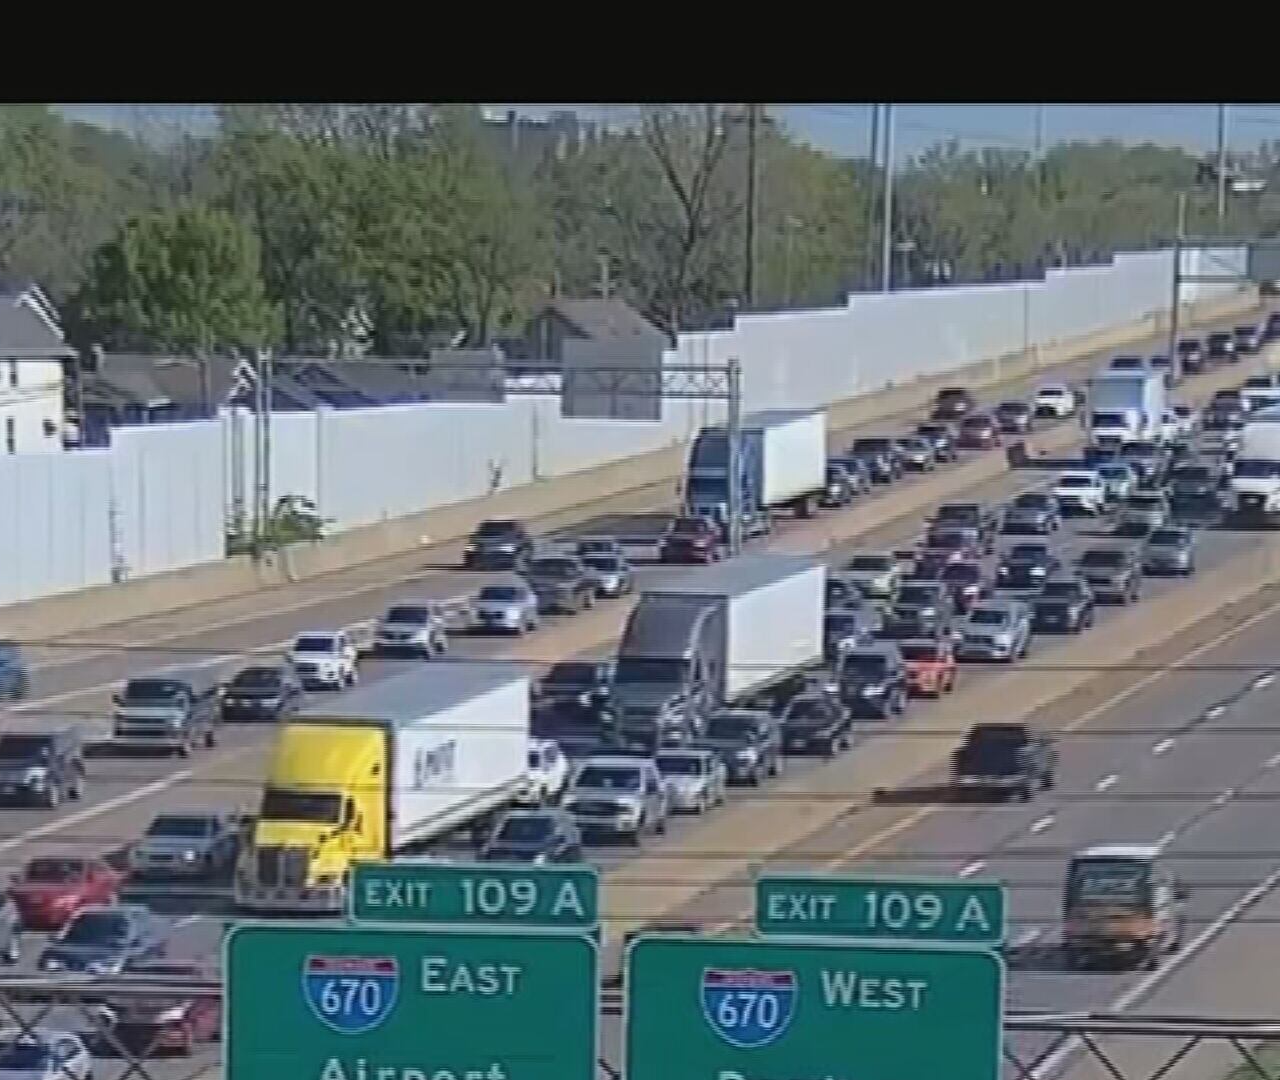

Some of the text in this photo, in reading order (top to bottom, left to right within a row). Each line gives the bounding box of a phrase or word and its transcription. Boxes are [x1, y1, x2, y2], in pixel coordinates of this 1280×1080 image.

[365, 879, 584, 916] EXIT 109 A
[768, 893, 989, 931] EXIT 109 A
[421, 957, 521, 996] EAST
[822, 971, 927, 1010] WEST
[321, 979, 381, 1015] 670
[717, 991, 779, 1028] 670
